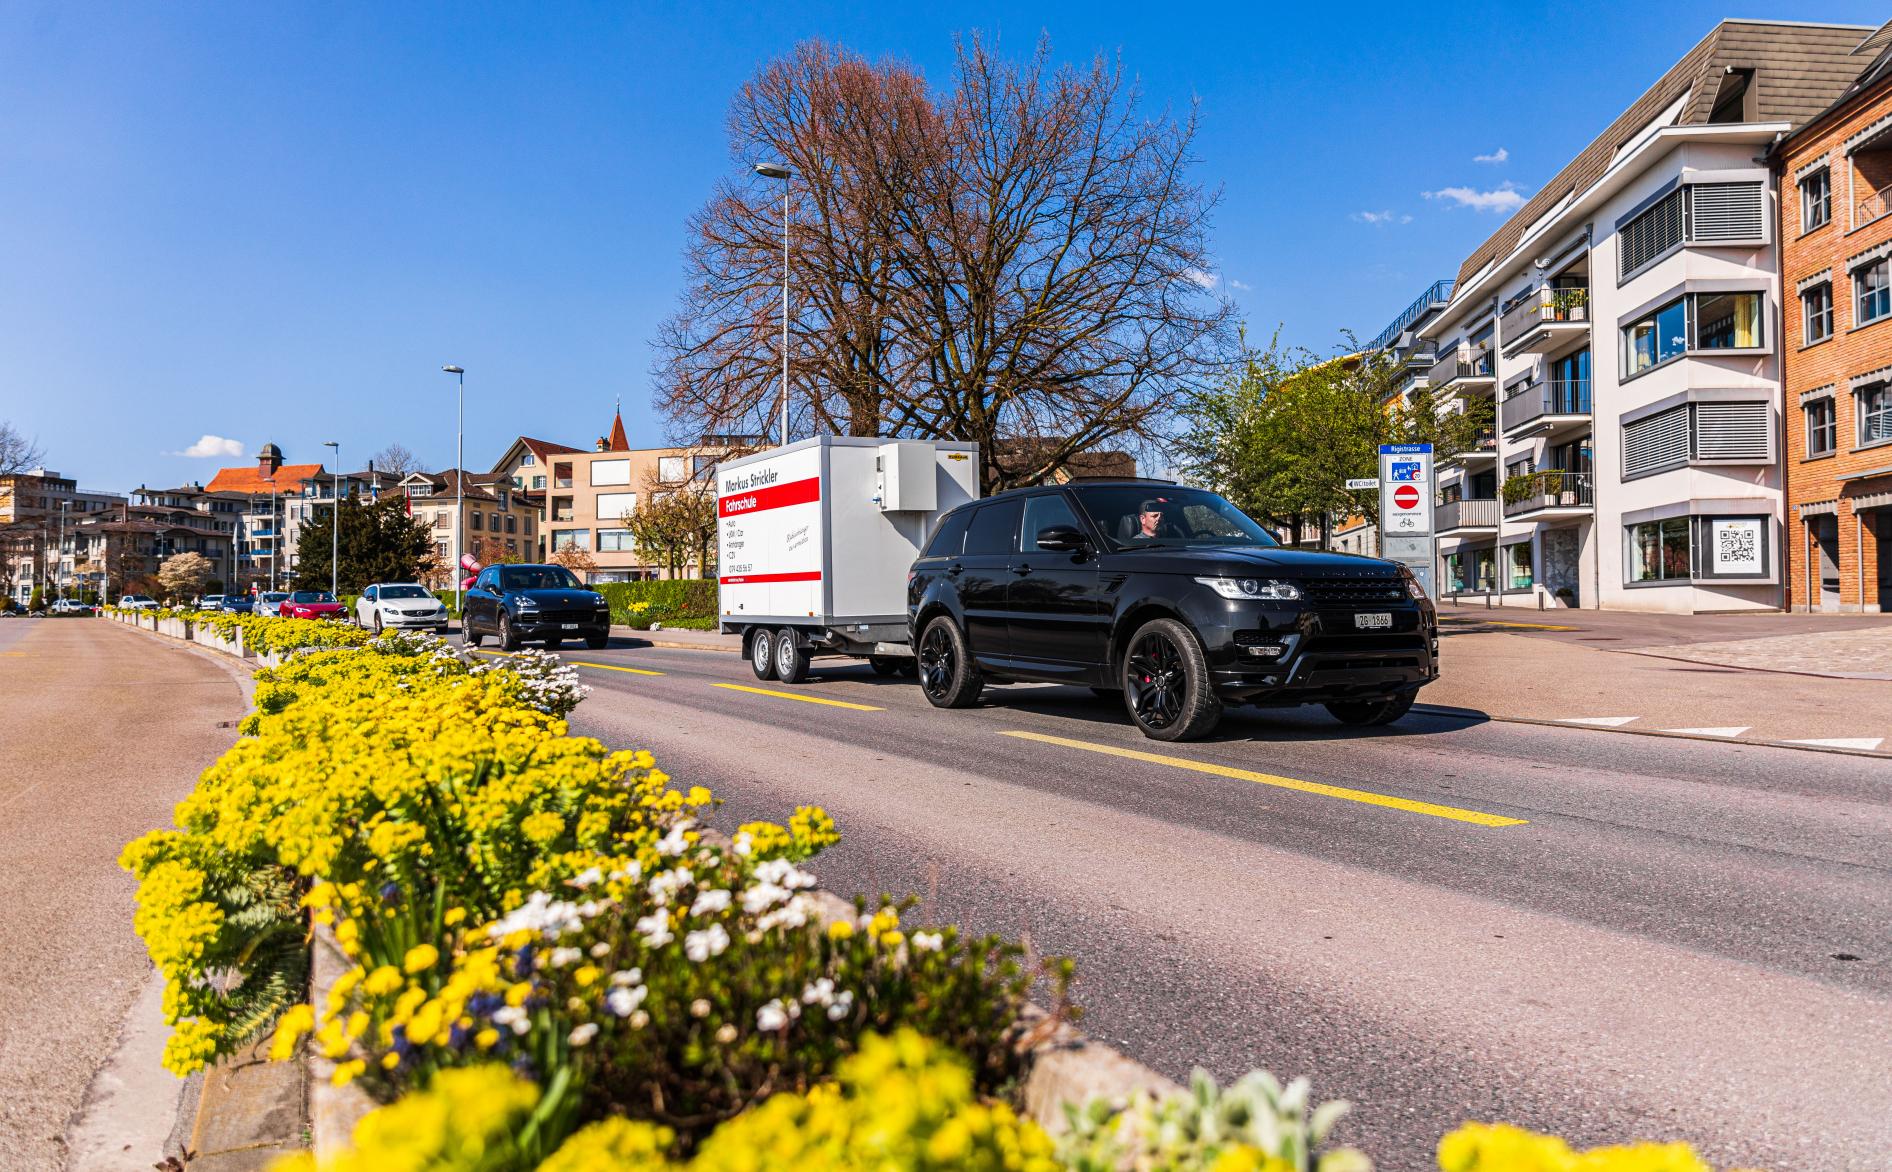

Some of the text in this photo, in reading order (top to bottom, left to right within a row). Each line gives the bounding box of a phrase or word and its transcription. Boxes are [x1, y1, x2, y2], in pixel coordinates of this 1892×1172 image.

[1391, 445, 1421, 454] Rigistrasse
[725, 468, 778, 493] Markus Strickler
[725, 495, 757, 512] Fahrschule
[1360, 615, 1368, 626] ZG
